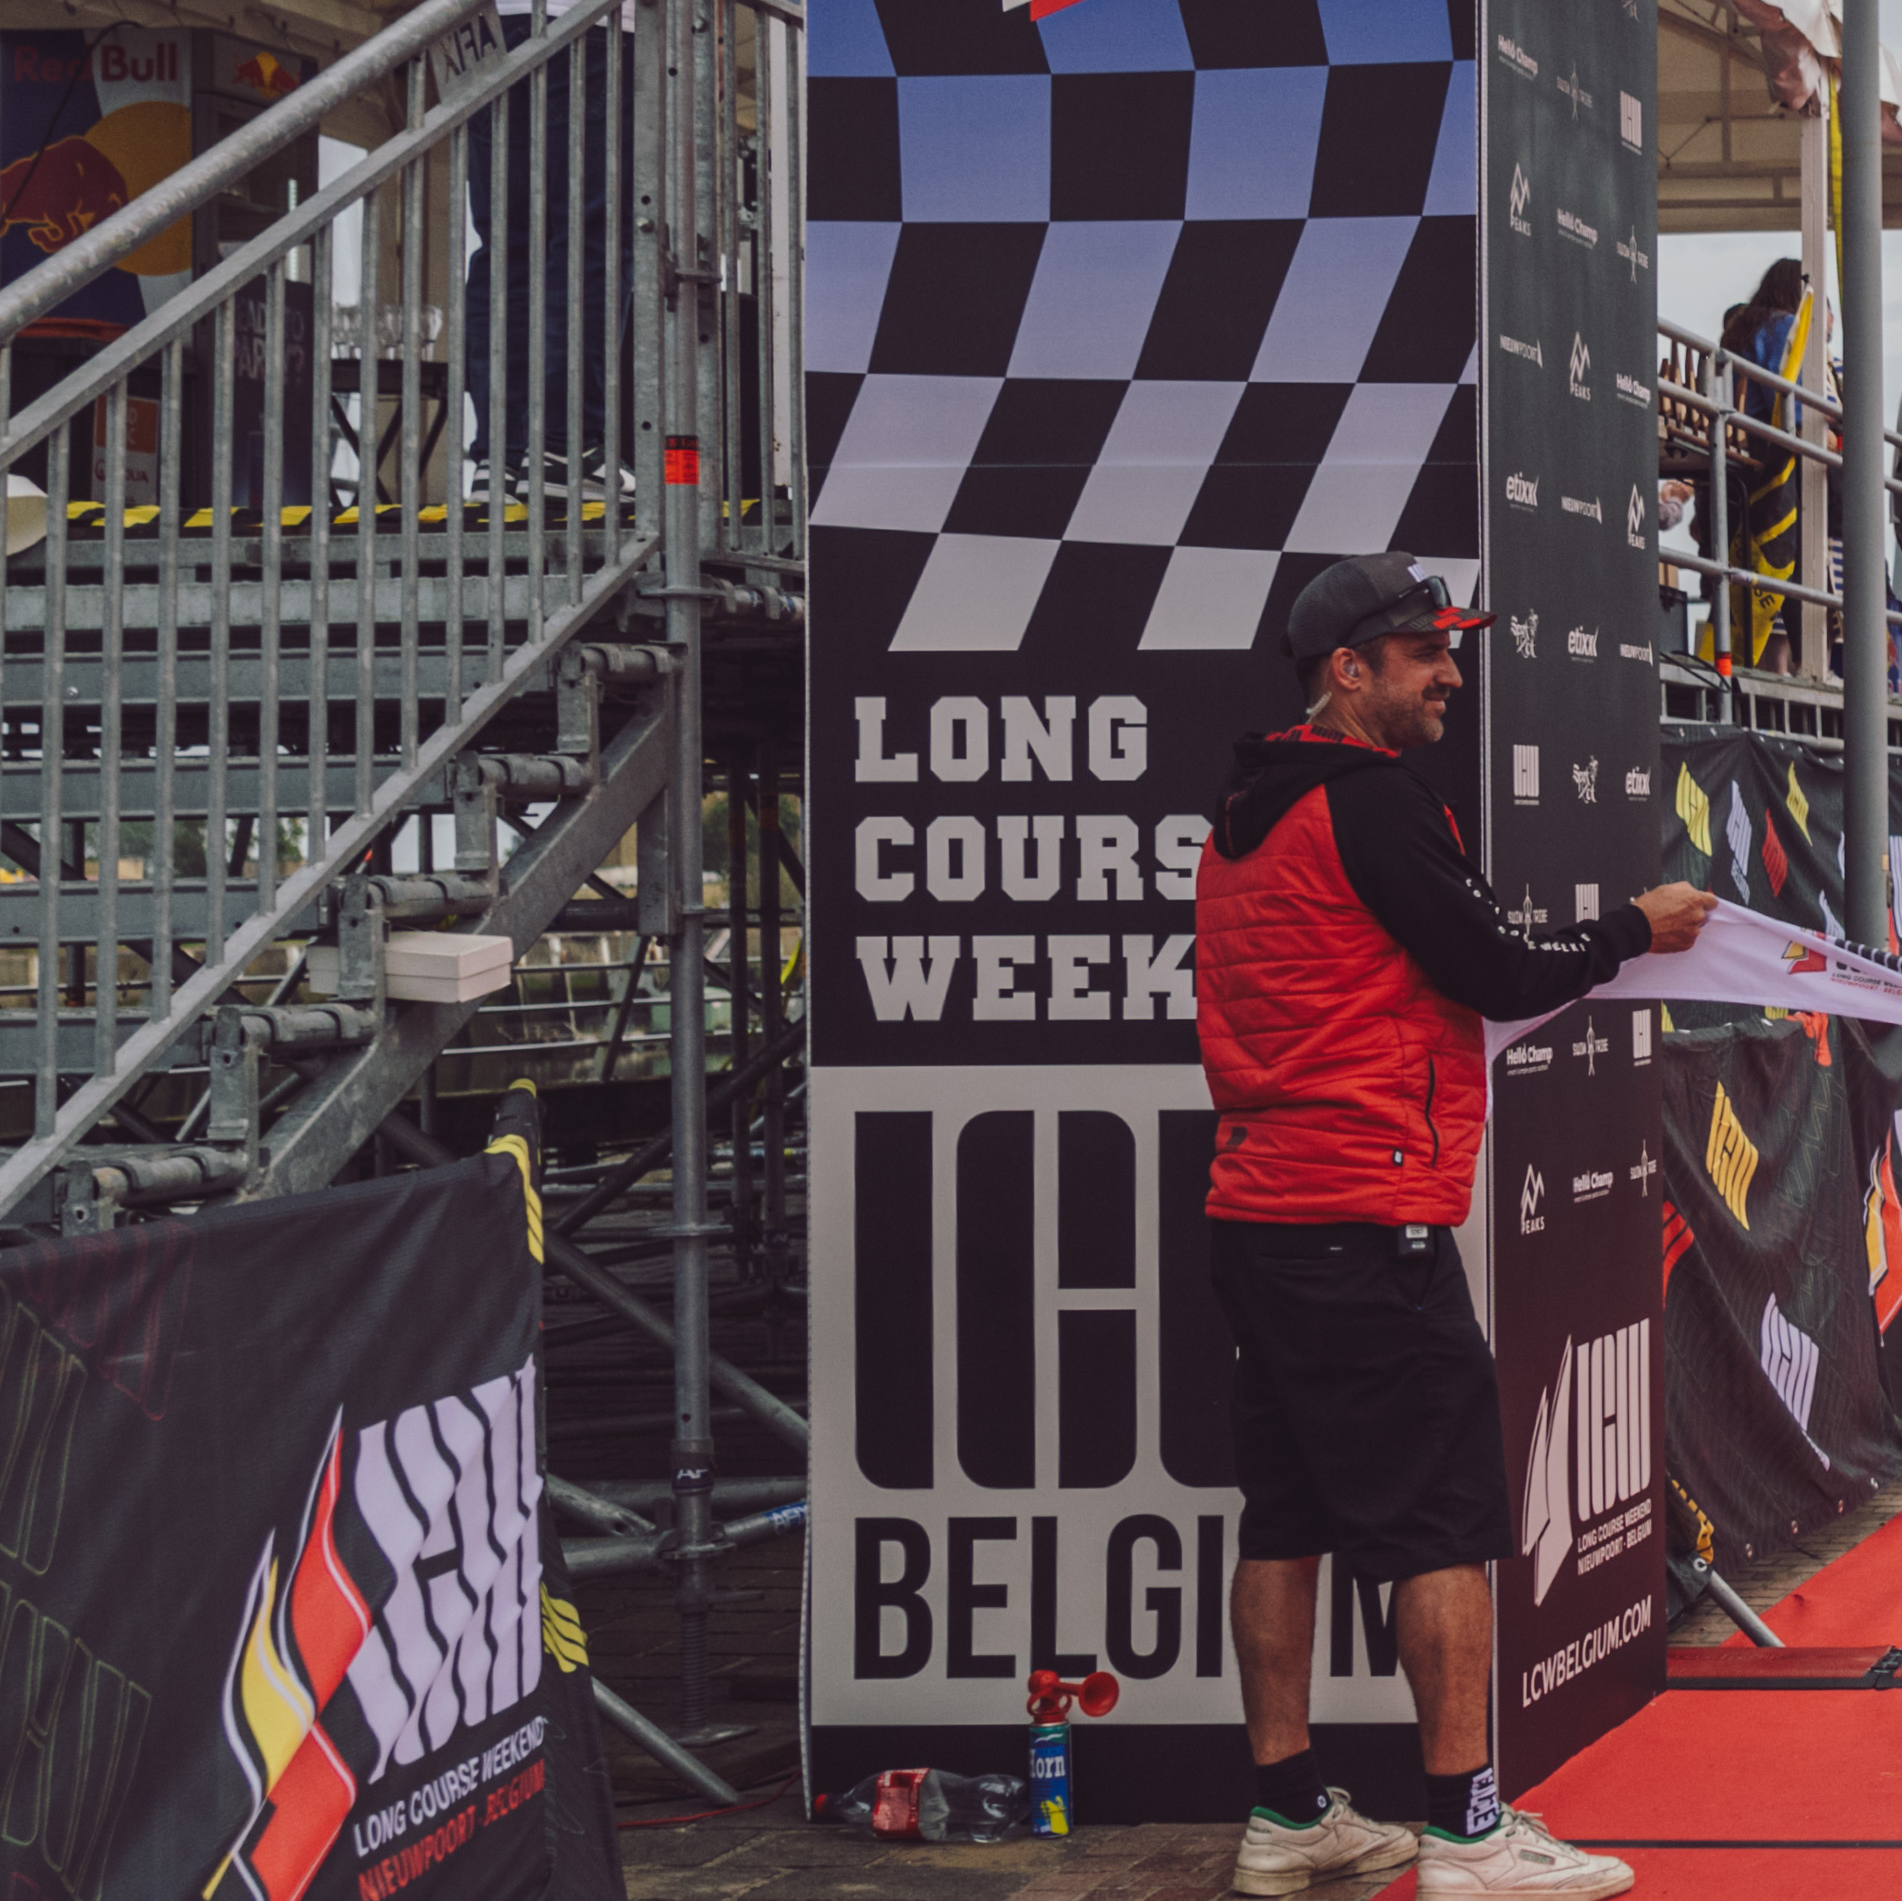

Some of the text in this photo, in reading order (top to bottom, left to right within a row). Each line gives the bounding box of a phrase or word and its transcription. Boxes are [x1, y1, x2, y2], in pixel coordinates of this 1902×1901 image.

[14, 43, 178, 83] Red Bull
[1510, 217, 1532, 237] PEAKS
[1570, 382, 1591, 401] PEAKS
[1627, 534, 1645, 549] PEAKS
[854, 695, 1148, 783] LONG
[1852, 976, 1881, 986] COURSE
[1521, 1217, 1545, 1235] PEAKS
[1577, 1497, 1652, 1554] LONG COURSE WEEKEND
[1577, 1517, 1652, 1576] NIEUWPOORT BELGIUM
[854, 1513, 1400, 1680] BELGIM
[1522, 1593, 1652, 1709] LCWBELGIUM.COM
[353, 1714, 545, 1859] LONG COURSE WEEKEND
[357, 1804, 477, 1901] NIEUWPOORT
